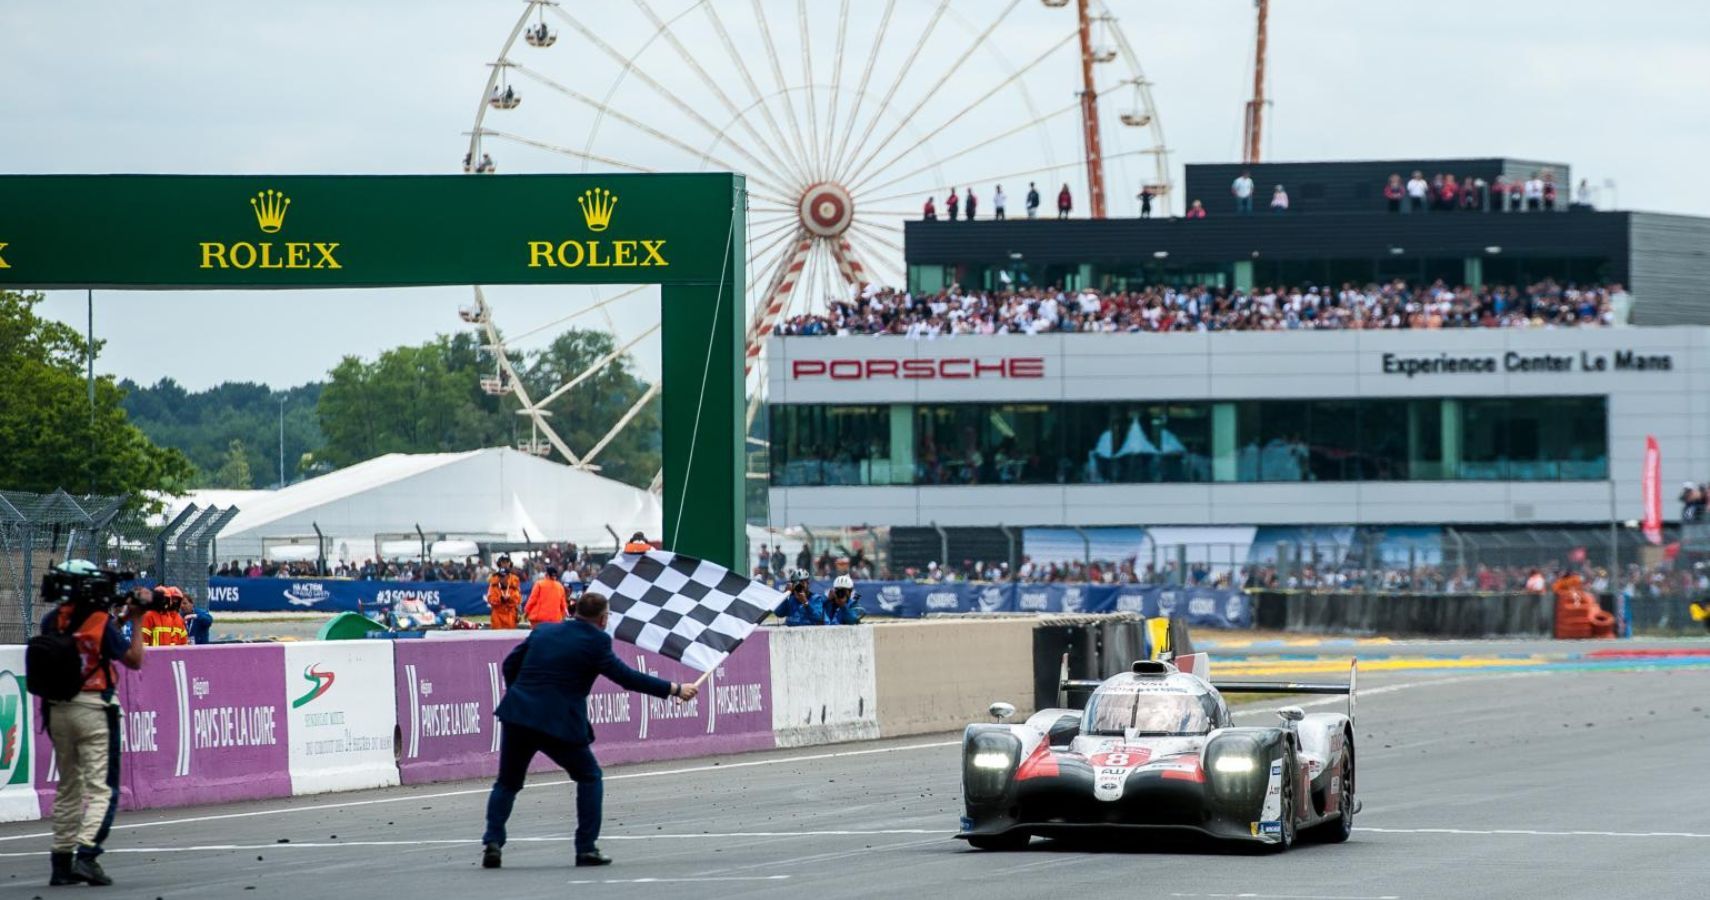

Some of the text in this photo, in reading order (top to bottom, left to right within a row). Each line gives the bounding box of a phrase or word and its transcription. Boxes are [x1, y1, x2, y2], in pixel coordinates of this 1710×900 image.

[199, 241, 343, 269] ROLEX
[527, 240, 669, 267] ROLEX
[793, 357, 1044, 380] PORSCHE
[1381, 349, 1673, 378] Experience Center Le Mans
[421, 702, 480, 737] PAYS DE LA LOIRE
[595, 693, 603, 723] DE
[604, 692, 612, 723] LA
[613, 692, 630, 722] LOIRE
[129, 711, 158, 752] LOIRE
[194, 706, 276, 749] PAYS DE LA LOIRE
[1104, 753, 1130, 766] 8
